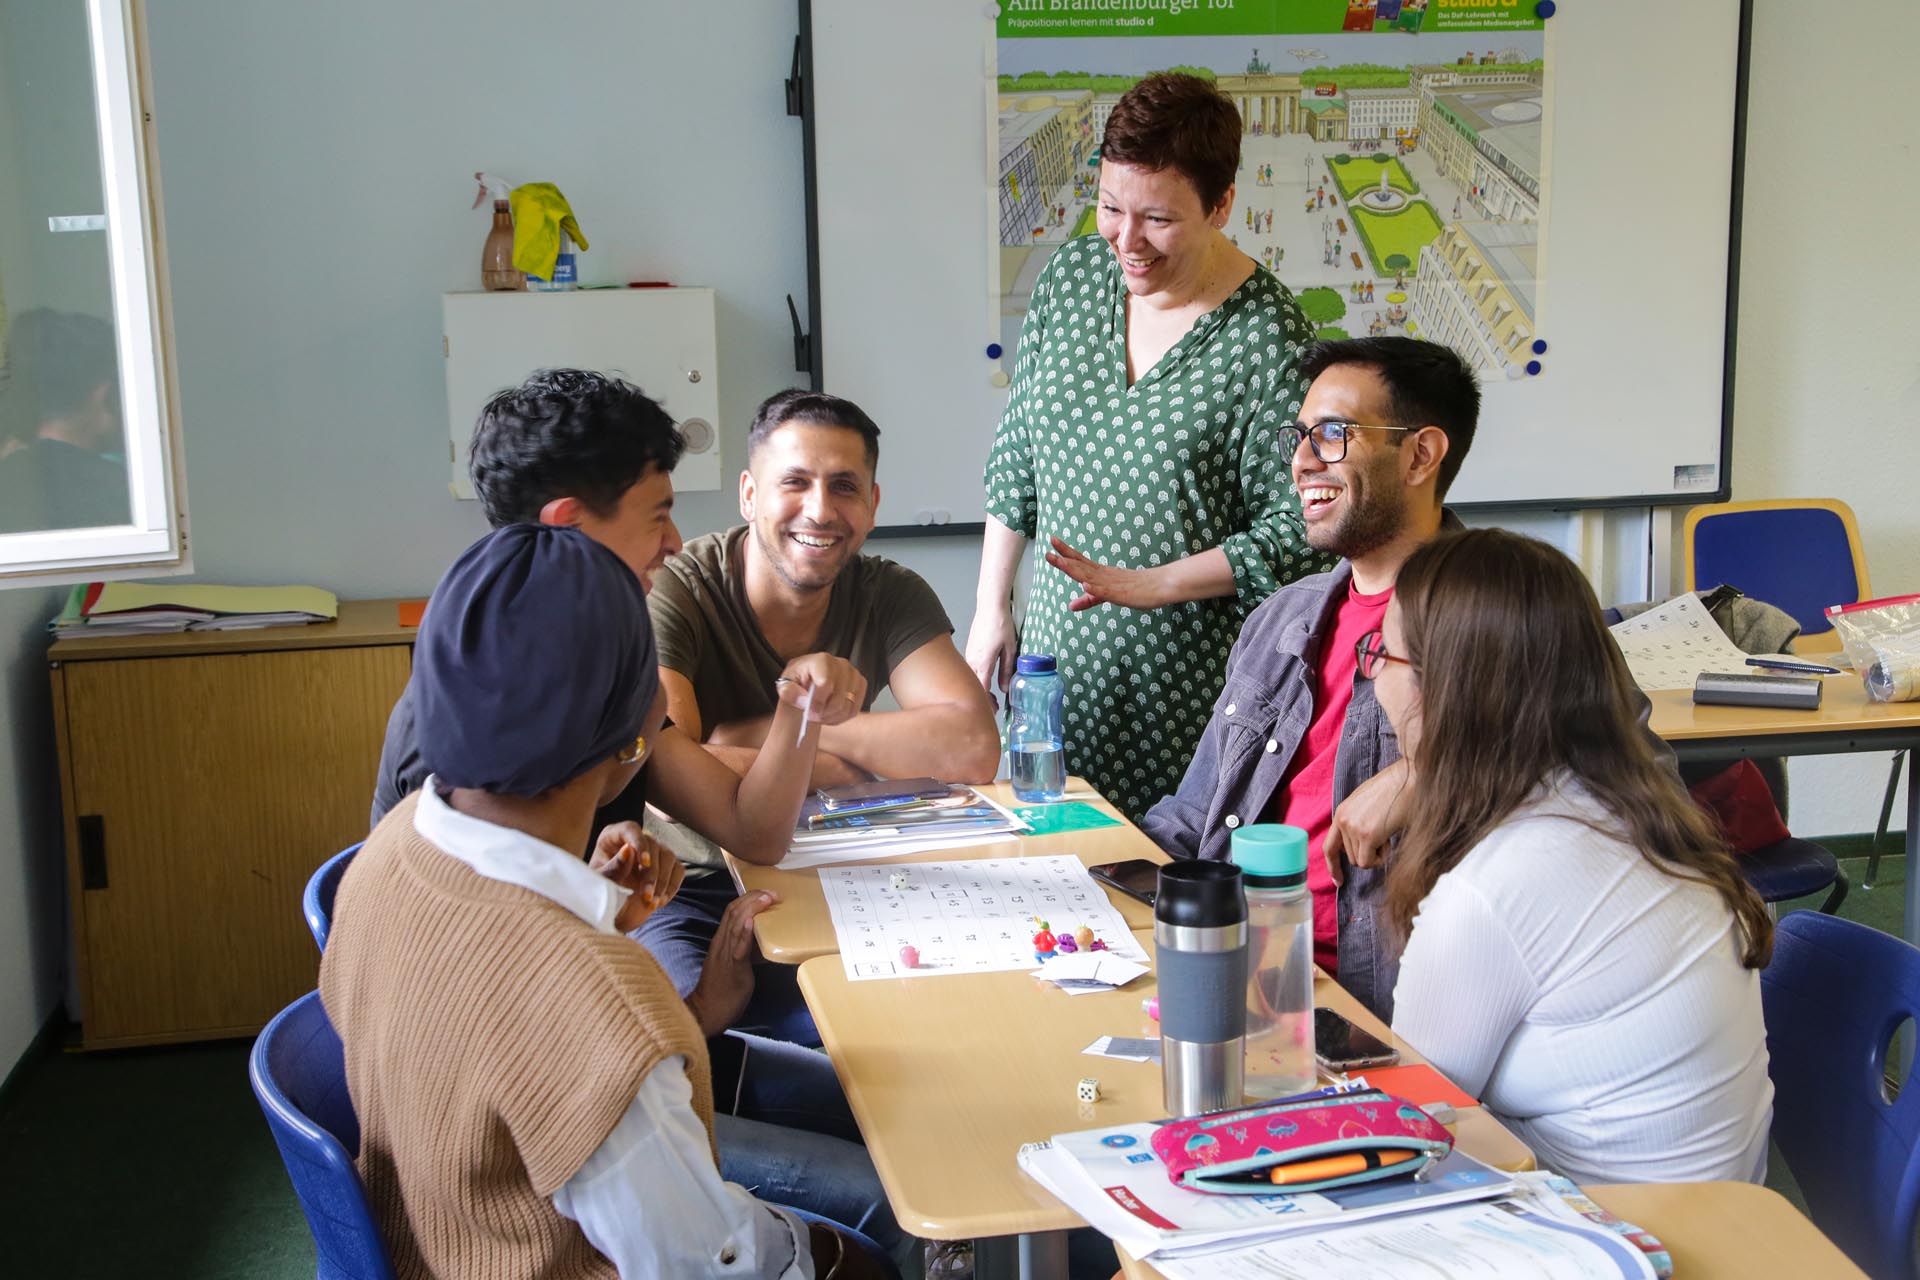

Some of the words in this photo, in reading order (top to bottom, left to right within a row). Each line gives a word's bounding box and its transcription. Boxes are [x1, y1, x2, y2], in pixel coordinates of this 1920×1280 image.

[1008, 0, 1044, 11] Am
[1050, 0, 1198, 15] Brandenburger
[1008, 17, 1068, 28] Präpositionen
[1070, 17, 1097, 26] lernen
[1099, 17, 1114, 26] mit
[1115, 16, 1145, 26] studio
[1147, 16, 1154, 26] d
